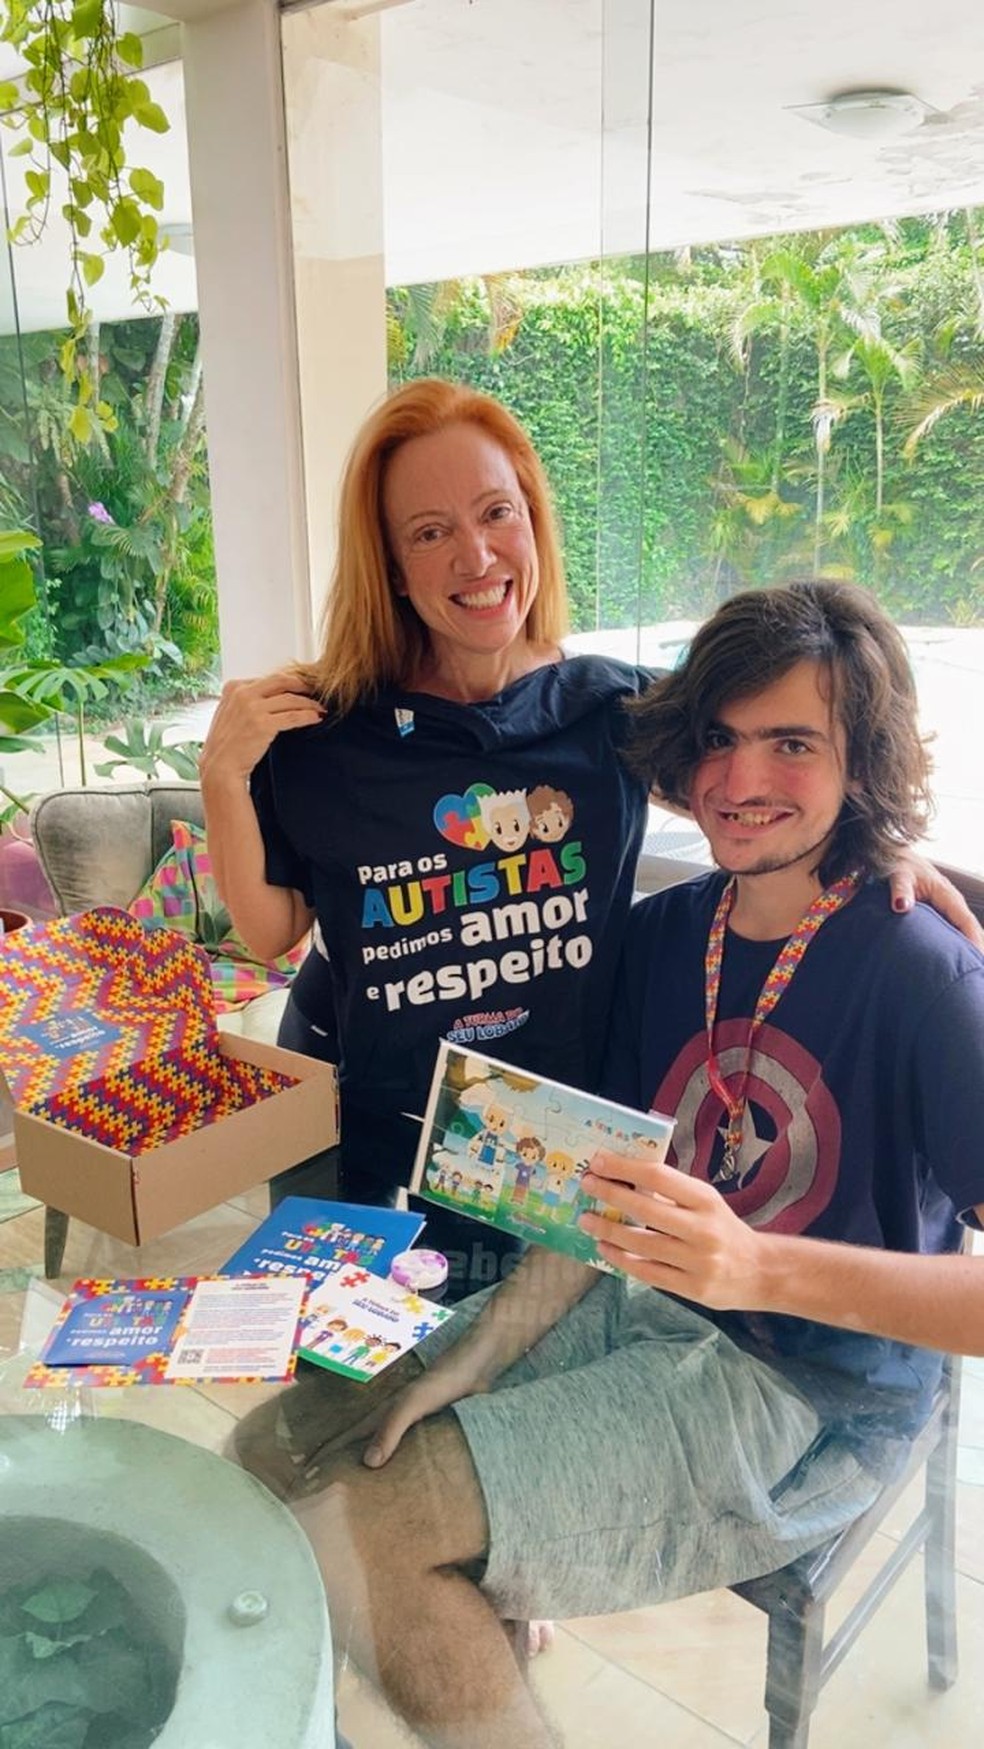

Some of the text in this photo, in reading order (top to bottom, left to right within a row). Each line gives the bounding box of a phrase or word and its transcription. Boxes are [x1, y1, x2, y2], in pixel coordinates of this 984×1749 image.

[357, 853, 448, 885] Para os
[361, 841, 587, 928] AUTISTAS
[361, 887, 589, 965] pedimos amor
[366, 934, 593, 1012] e respeito
[303, 1256, 342, 1272] am
[70, 1334, 159, 1348] respeito
[109, 1325, 163, 1336] amor
